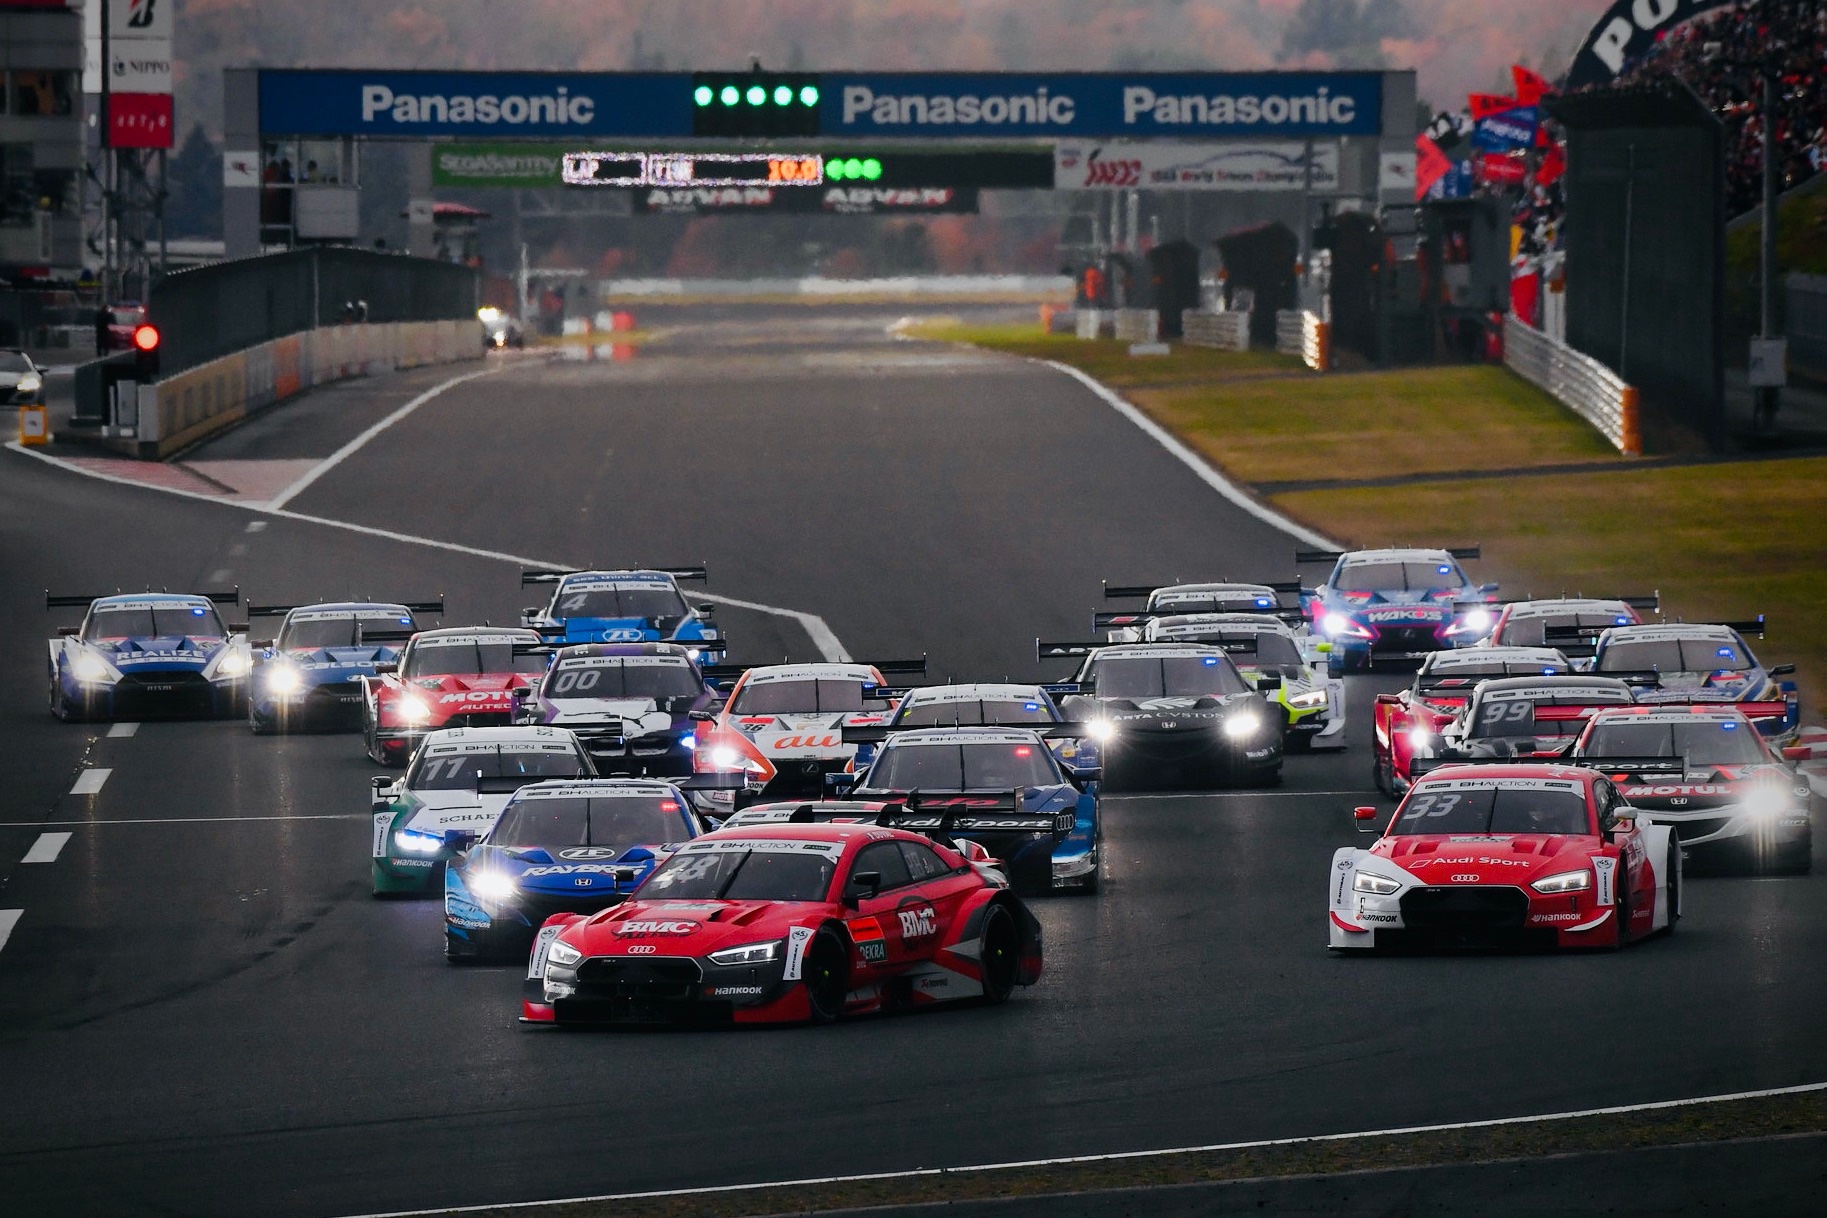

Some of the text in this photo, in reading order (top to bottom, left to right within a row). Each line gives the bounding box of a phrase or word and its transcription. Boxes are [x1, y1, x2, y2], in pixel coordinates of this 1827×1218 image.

[362, 86, 595, 125] Panasonic
[842, 86, 1075, 125] Panasonic
[1123, 86, 1356, 125] Panasonic
[561, 593, 589, 611] 4
[116, 650, 205, 660] REALIZE
[554, 670, 602, 693] 00
[458, 703, 512, 711] AUTEC
[1481, 702, 1532, 724] 99
[774, 734, 842, 749] au
[425, 756, 468, 781] 11
[1625, 785, 1732, 797] MOTUL
[1402, 794, 1462, 820] 33
[1432, 856, 1530, 868] Audi Sport
[617, 919, 697, 934] BMC
[898, 907, 938, 939] BMC
[859, 943, 885, 961] DEKRA
